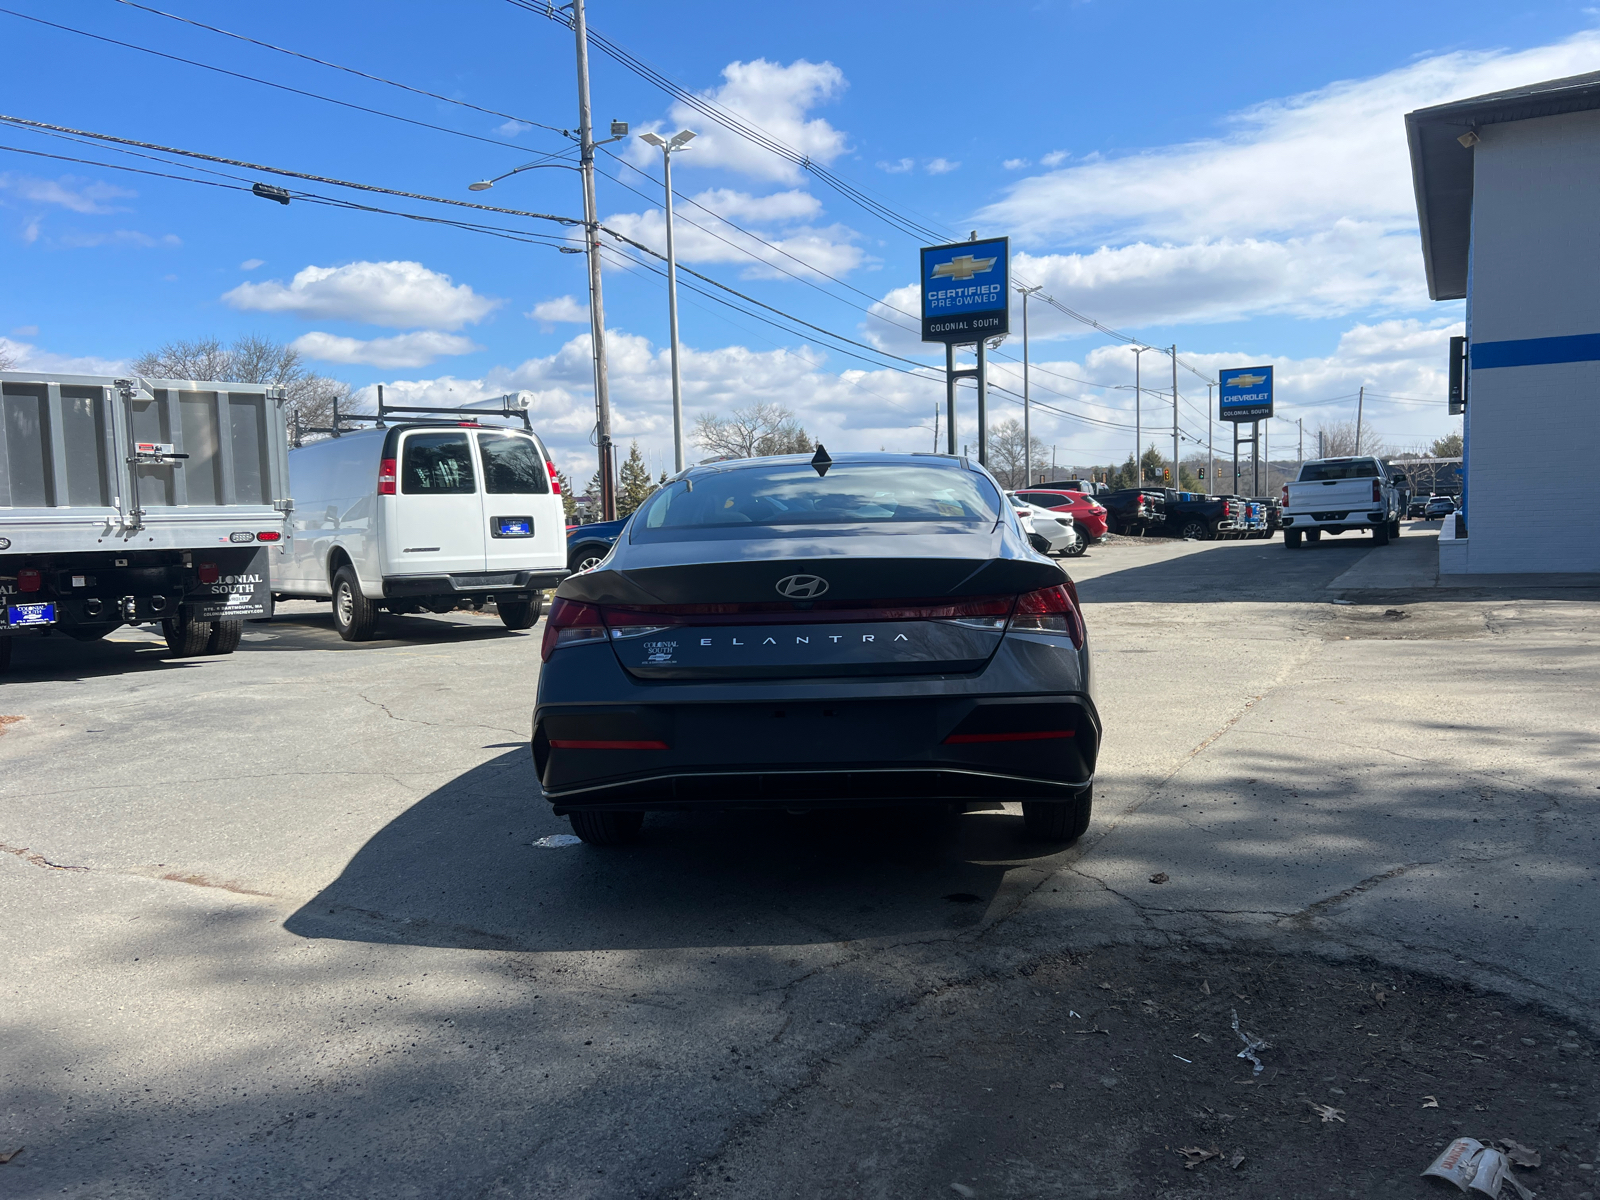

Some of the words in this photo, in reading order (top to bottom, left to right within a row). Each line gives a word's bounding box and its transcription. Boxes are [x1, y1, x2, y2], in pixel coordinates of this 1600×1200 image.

[928, 284, 1000, 300] CERTIFIED
[931, 294, 997, 308] PRE-OWNED
[930, 321, 968, 332] COLONIAL
[973, 318, 999, 328] SOUTH
[1223, 393, 1268, 402] CHEVROLET
[203, 574, 263, 584] LONIAL
[211, 584, 254, 594] SOUTH
[643, 640, 679, 649] COLONIAL
[700, 633, 909, 646] ELANTRA
